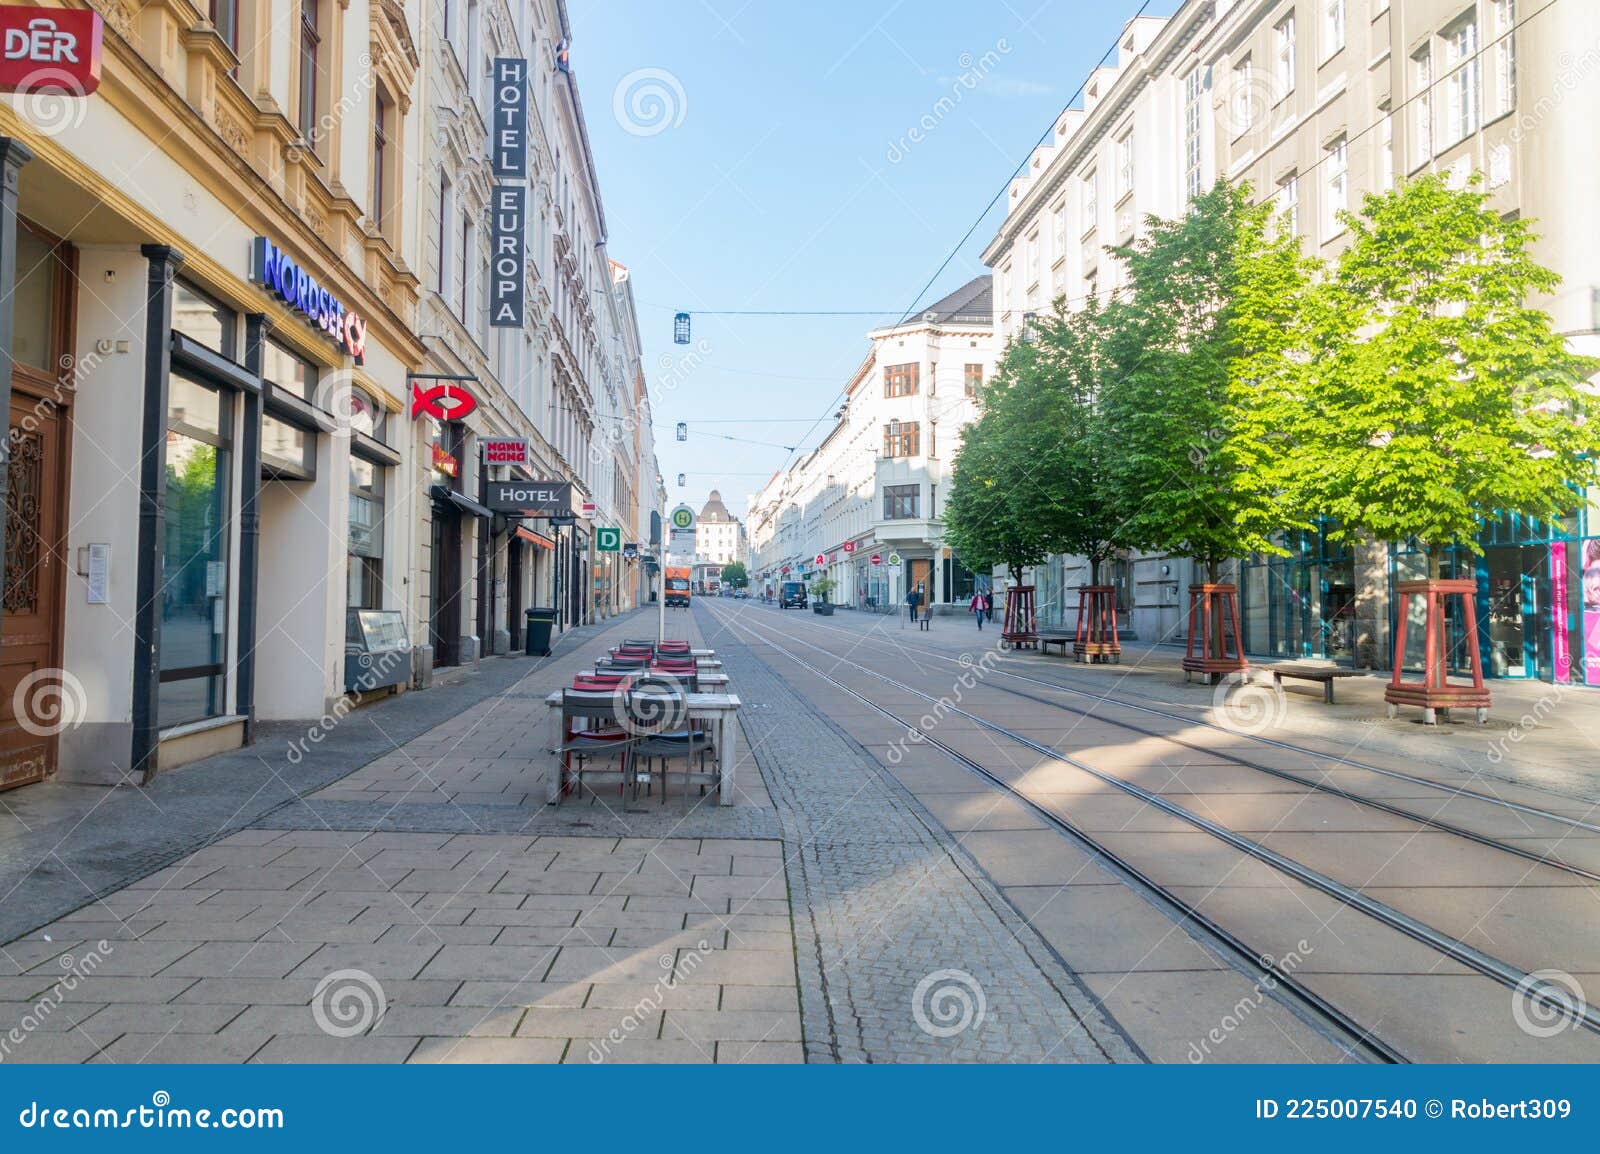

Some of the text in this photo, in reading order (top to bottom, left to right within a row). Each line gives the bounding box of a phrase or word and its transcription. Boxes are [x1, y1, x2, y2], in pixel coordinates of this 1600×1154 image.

[5, 27, 79, 63] DER
[501, 63, 520, 170] HOTEL
[256, 236, 344, 343] NORDSEE
[496, 192, 518, 321] EUROPA
[601, 531, 617, 548] D
